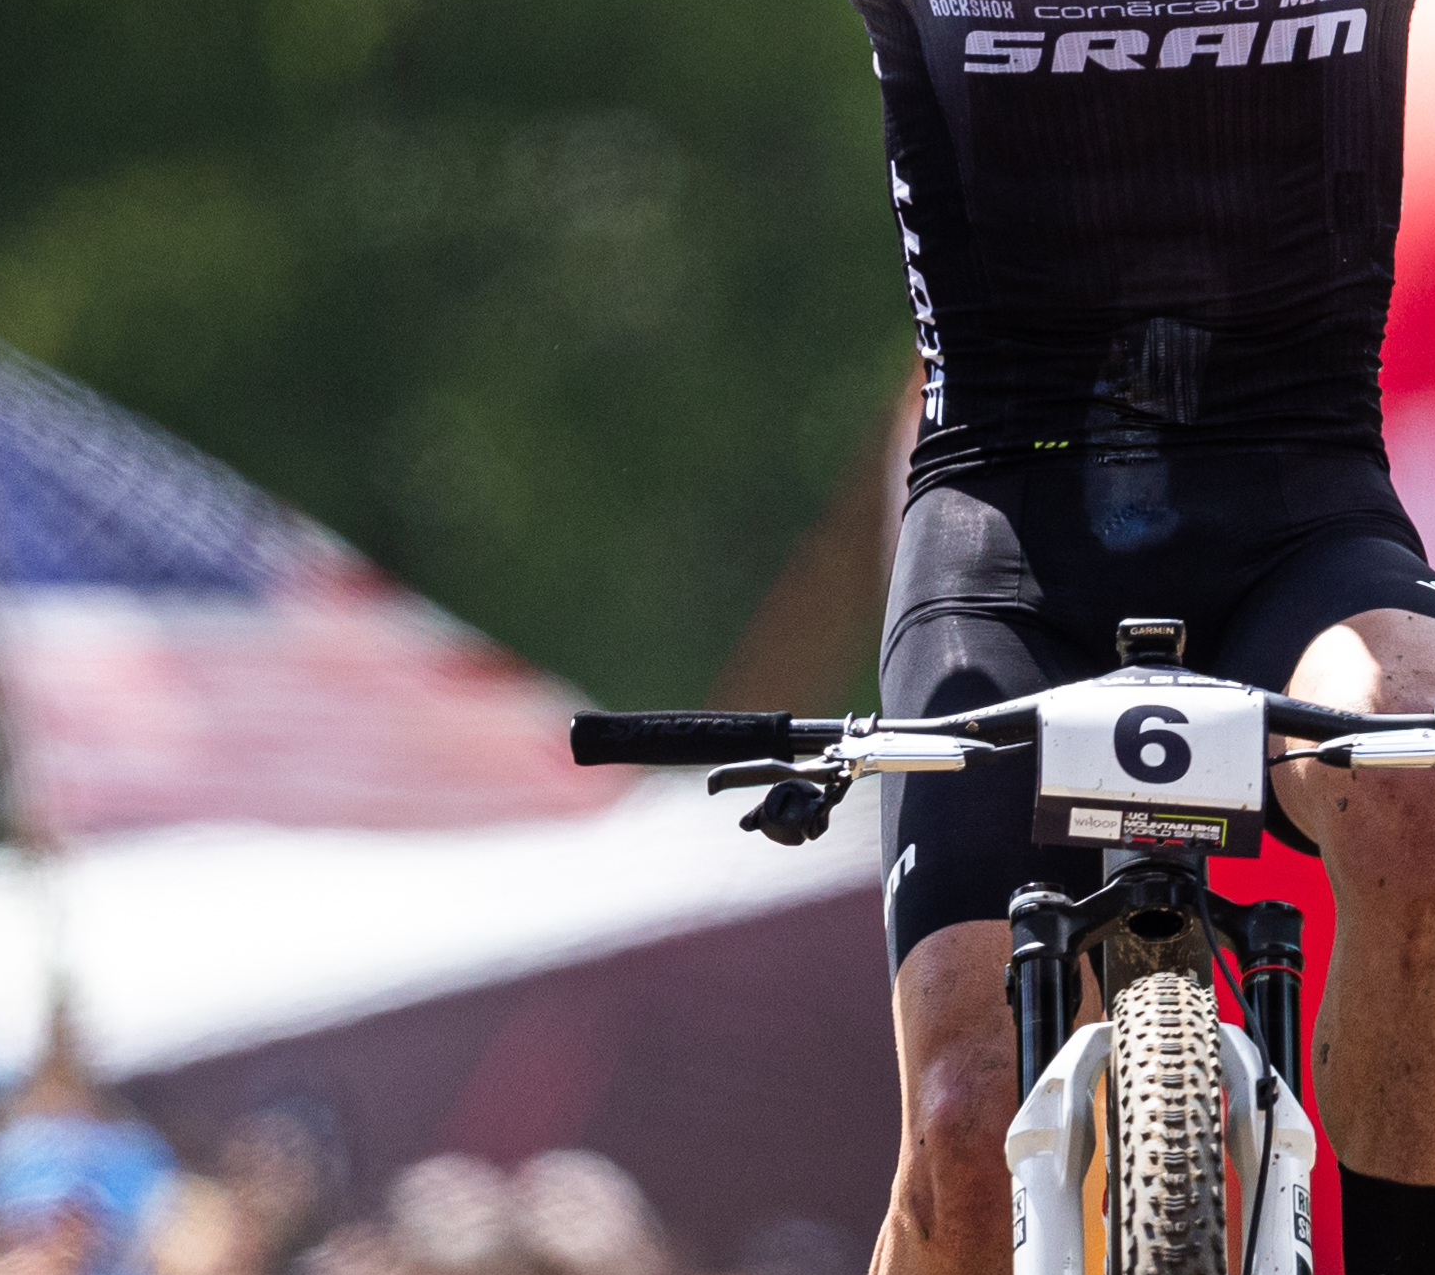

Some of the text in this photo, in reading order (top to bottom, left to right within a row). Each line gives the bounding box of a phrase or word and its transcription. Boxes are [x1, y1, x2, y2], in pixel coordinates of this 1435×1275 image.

[964, 8, 1367, 74] SRAM
[1129, 626, 1175, 636] GARMIN
[1113, 704, 1192, 785] 6
[1073, 816, 1118, 830] WHOOP
[1129, 812, 1149, 821] UCI
[1123, 820, 1221, 833] MOUNTAIN BIKE
[1123, 826, 1171, 837] WORLD
